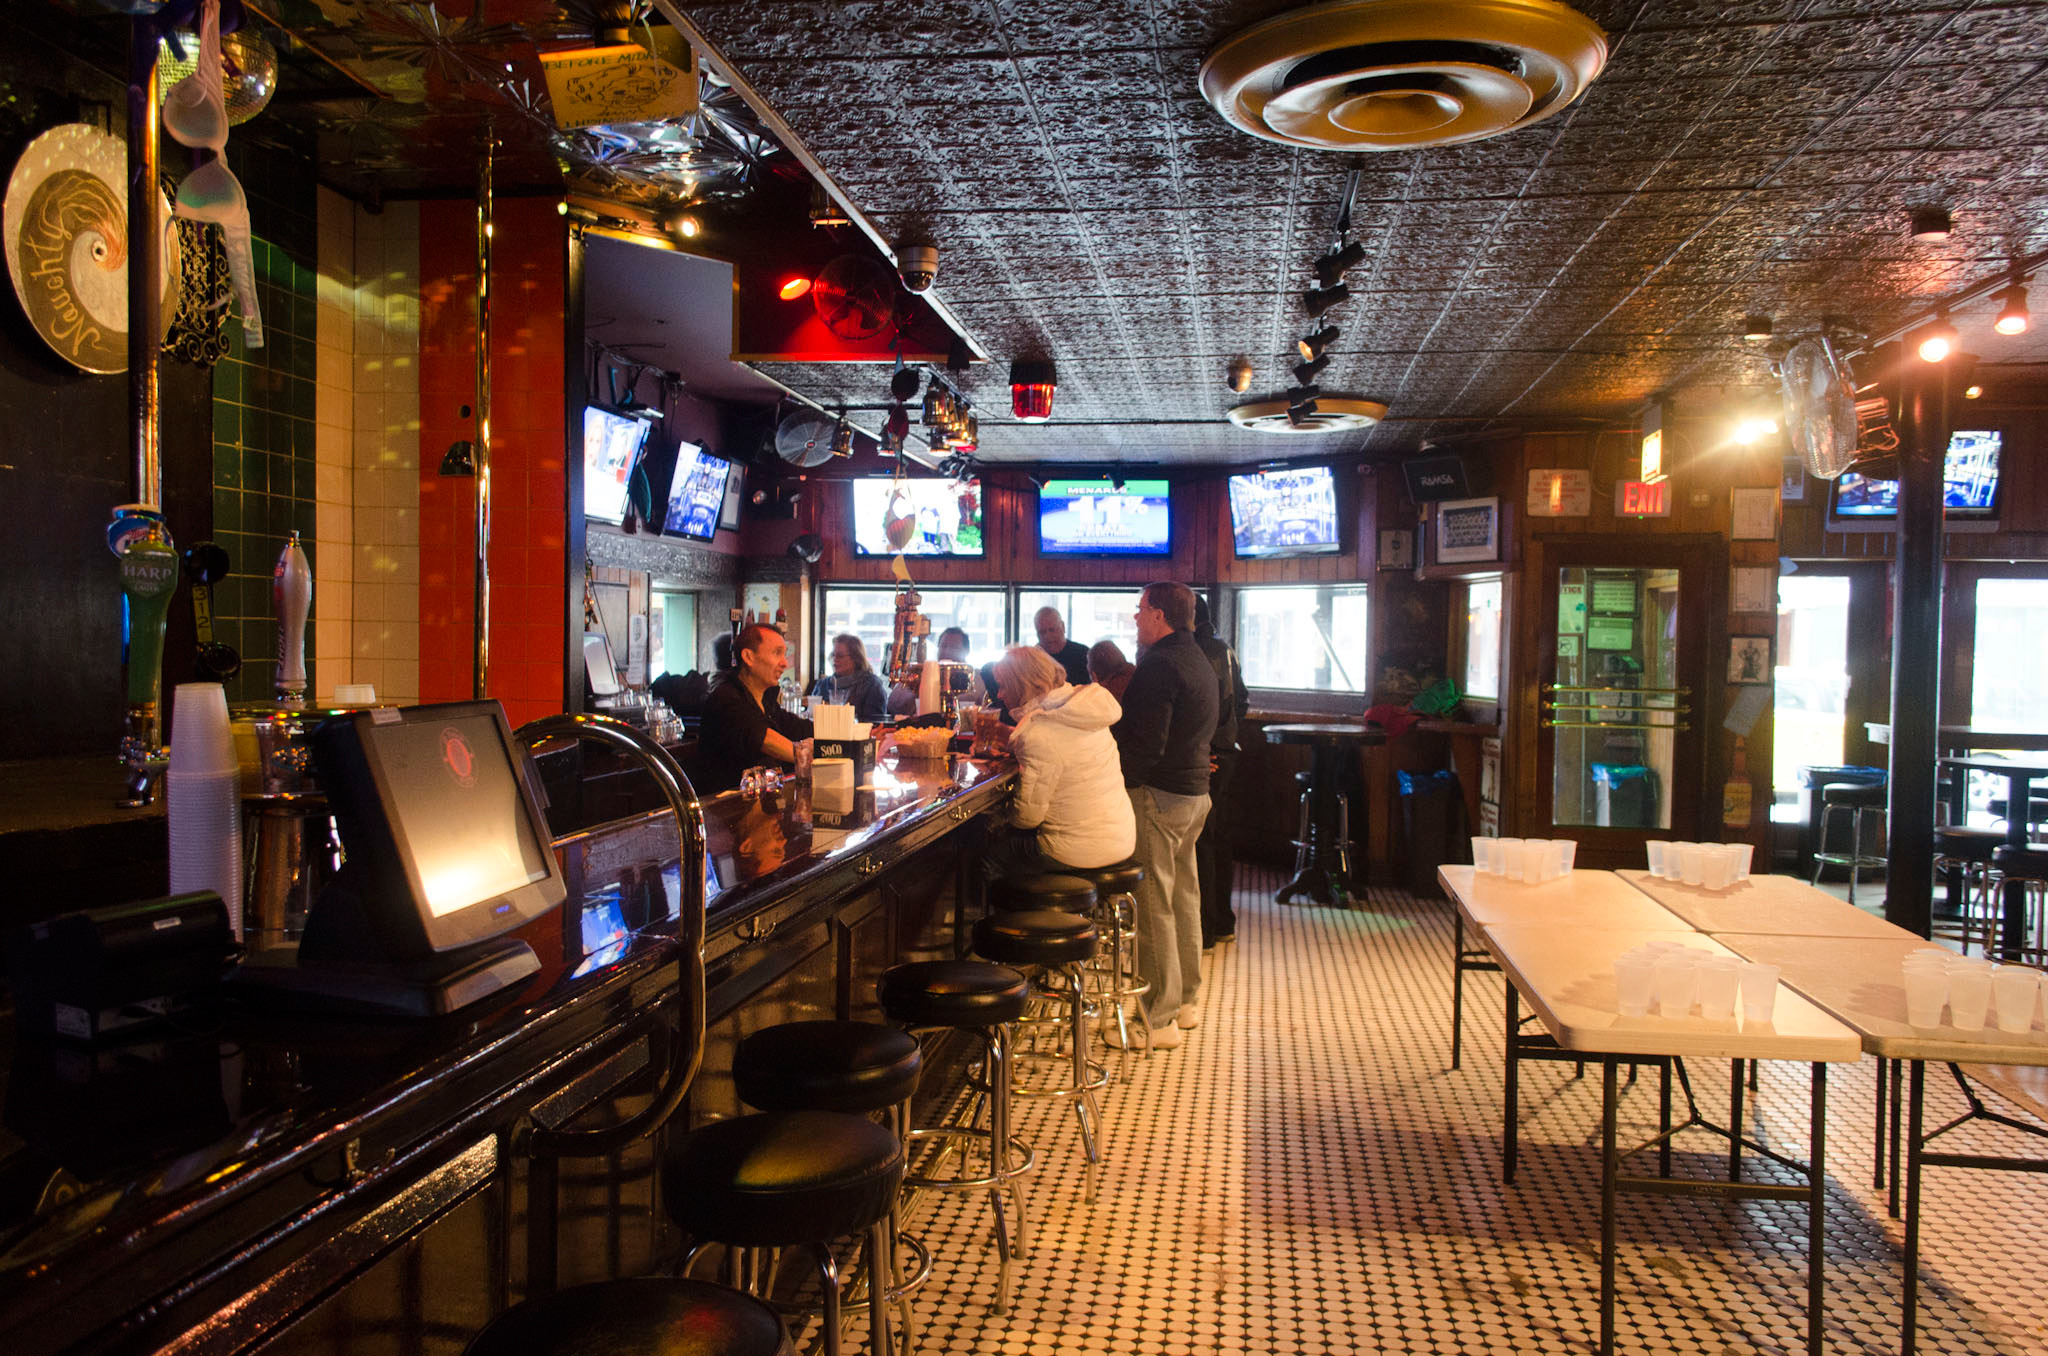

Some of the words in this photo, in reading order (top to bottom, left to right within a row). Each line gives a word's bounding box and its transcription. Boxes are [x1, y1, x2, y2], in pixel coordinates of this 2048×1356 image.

[542, 55, 610, 71] BEFORE
[1623, 482, 1666, 513] EXIT
[124, 564, 172, 581] HARP
